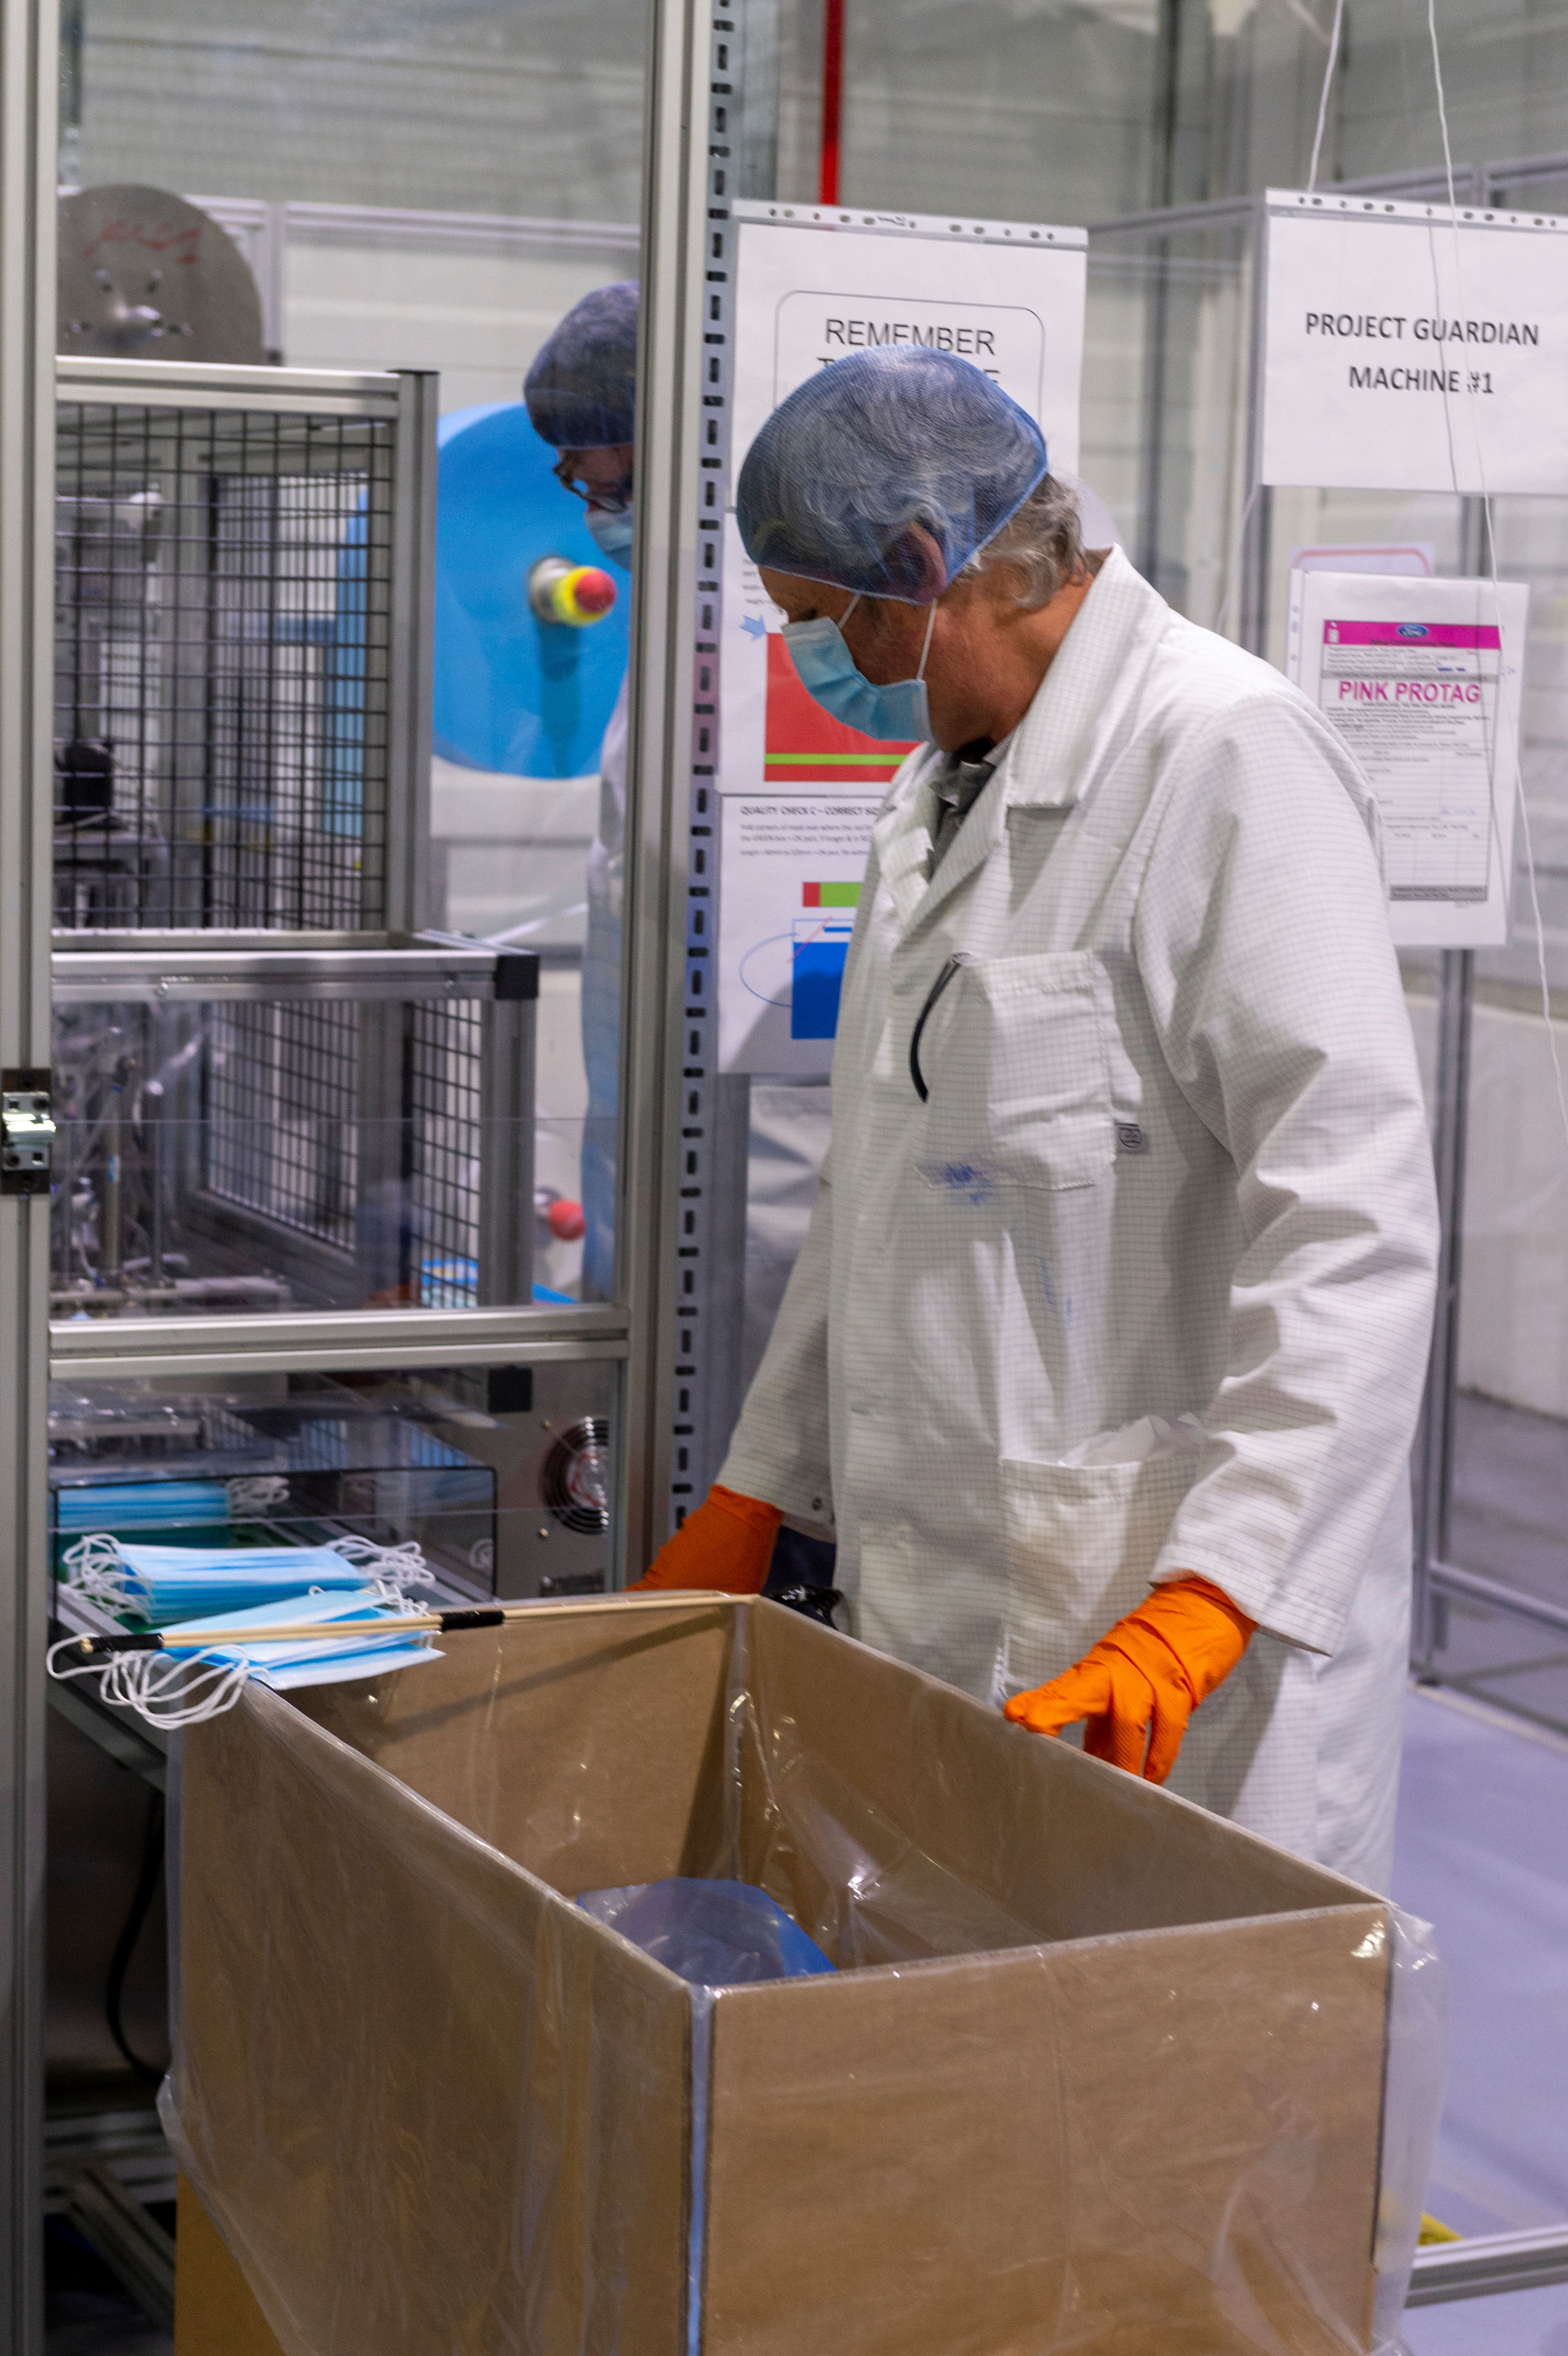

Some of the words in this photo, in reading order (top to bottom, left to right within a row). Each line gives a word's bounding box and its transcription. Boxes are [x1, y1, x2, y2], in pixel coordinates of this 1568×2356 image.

[826, 318, 996, 355] REMEMBER
[1305, 312, 1406, 339] PROJECT
[1413, 318, 1540, 346] GUARDIAN
[1348, 365, 1460, 393] MACHINE
[1466, 371, 1494, 394] #1
[1339, 681, 1389, 700] PINK
[1395, 682, 1481, 703] PROTAG
[740, 806, 777, 815] QUALITY
[780, 806, 809, 815] CHECK
[825, 806, 862, 815] CORRECT
